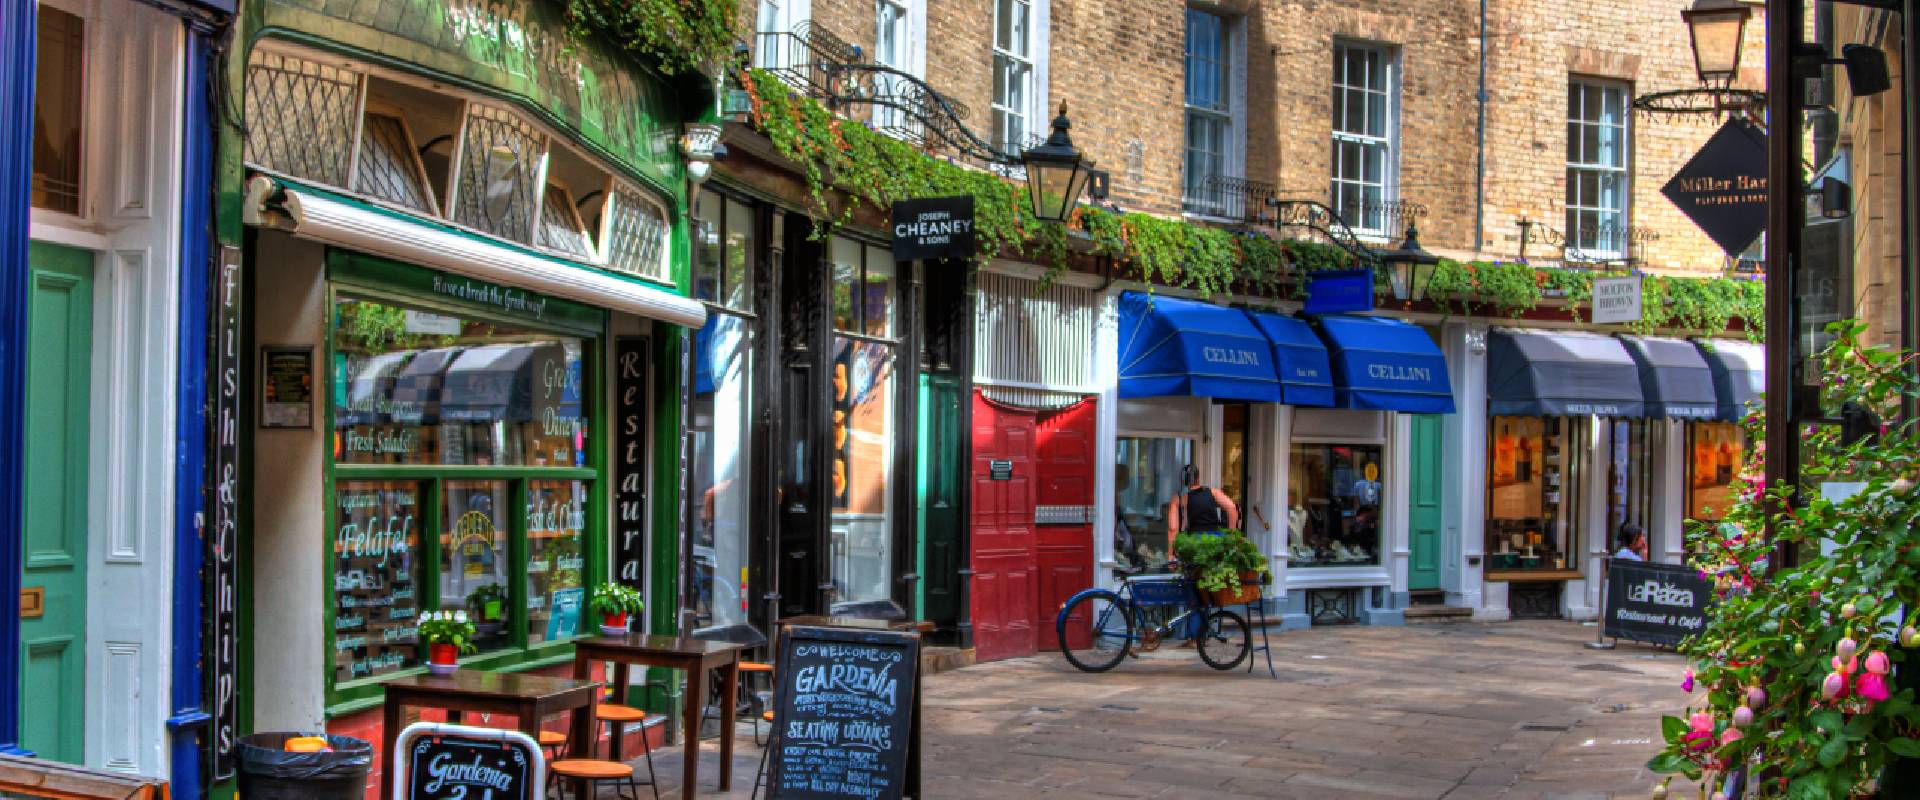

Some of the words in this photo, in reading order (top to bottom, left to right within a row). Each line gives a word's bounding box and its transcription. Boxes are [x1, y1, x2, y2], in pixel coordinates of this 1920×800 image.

[1680, 176, 1732, 193] Miller
[895, 219, 972, 238] CHEANEY
[918, 211, 951, 222] JOSEPH
[221, 263, 239, 447] Fish
[1202, 346, 1260, 367] CELLINI
[1368, 363, 1432, 382] CELLINI
[347, 427, 374, 453] Fresh
[619, 350, 642, 633] Restaurat
[338, 514, 414, 569] Felafel
[1616, 606, 1667, 624] Restaurant
[219, 505, 234, 754] Chips
[819, 645, 880, 662] WELCOME
[795, 662, 898, 706] GARDENIA
[787, 720, 840, 745] SEATING
[424, 752, 513, 793] Gardenia
